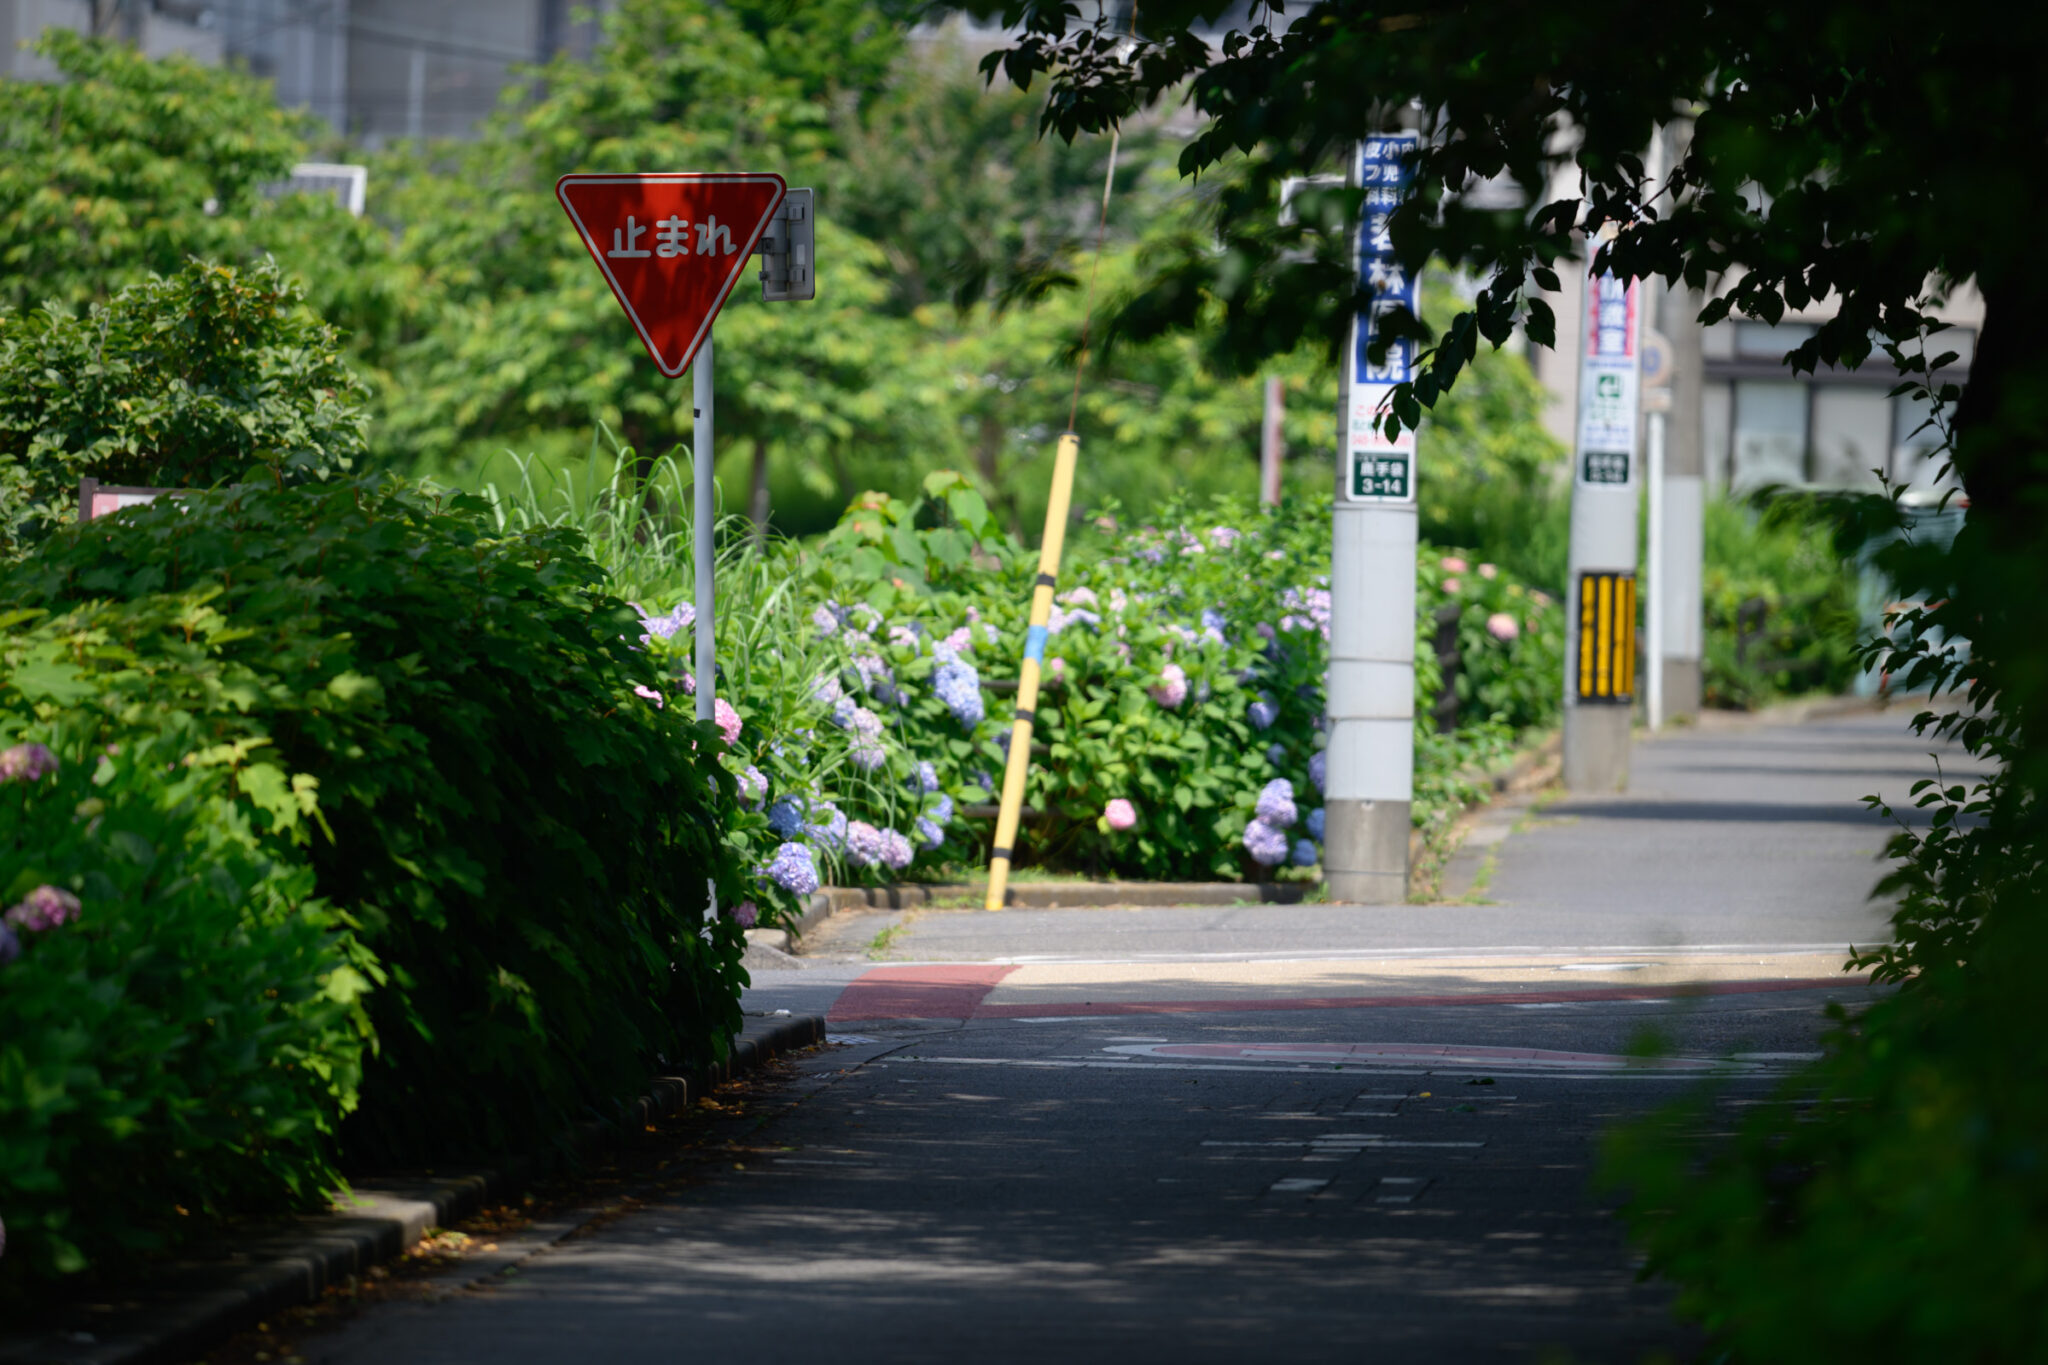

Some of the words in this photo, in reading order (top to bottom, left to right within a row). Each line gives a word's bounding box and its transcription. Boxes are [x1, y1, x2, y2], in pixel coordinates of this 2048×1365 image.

[607, 214, 737, 258] 止まれ
[1362, 478, 1402, 495] 3-14
